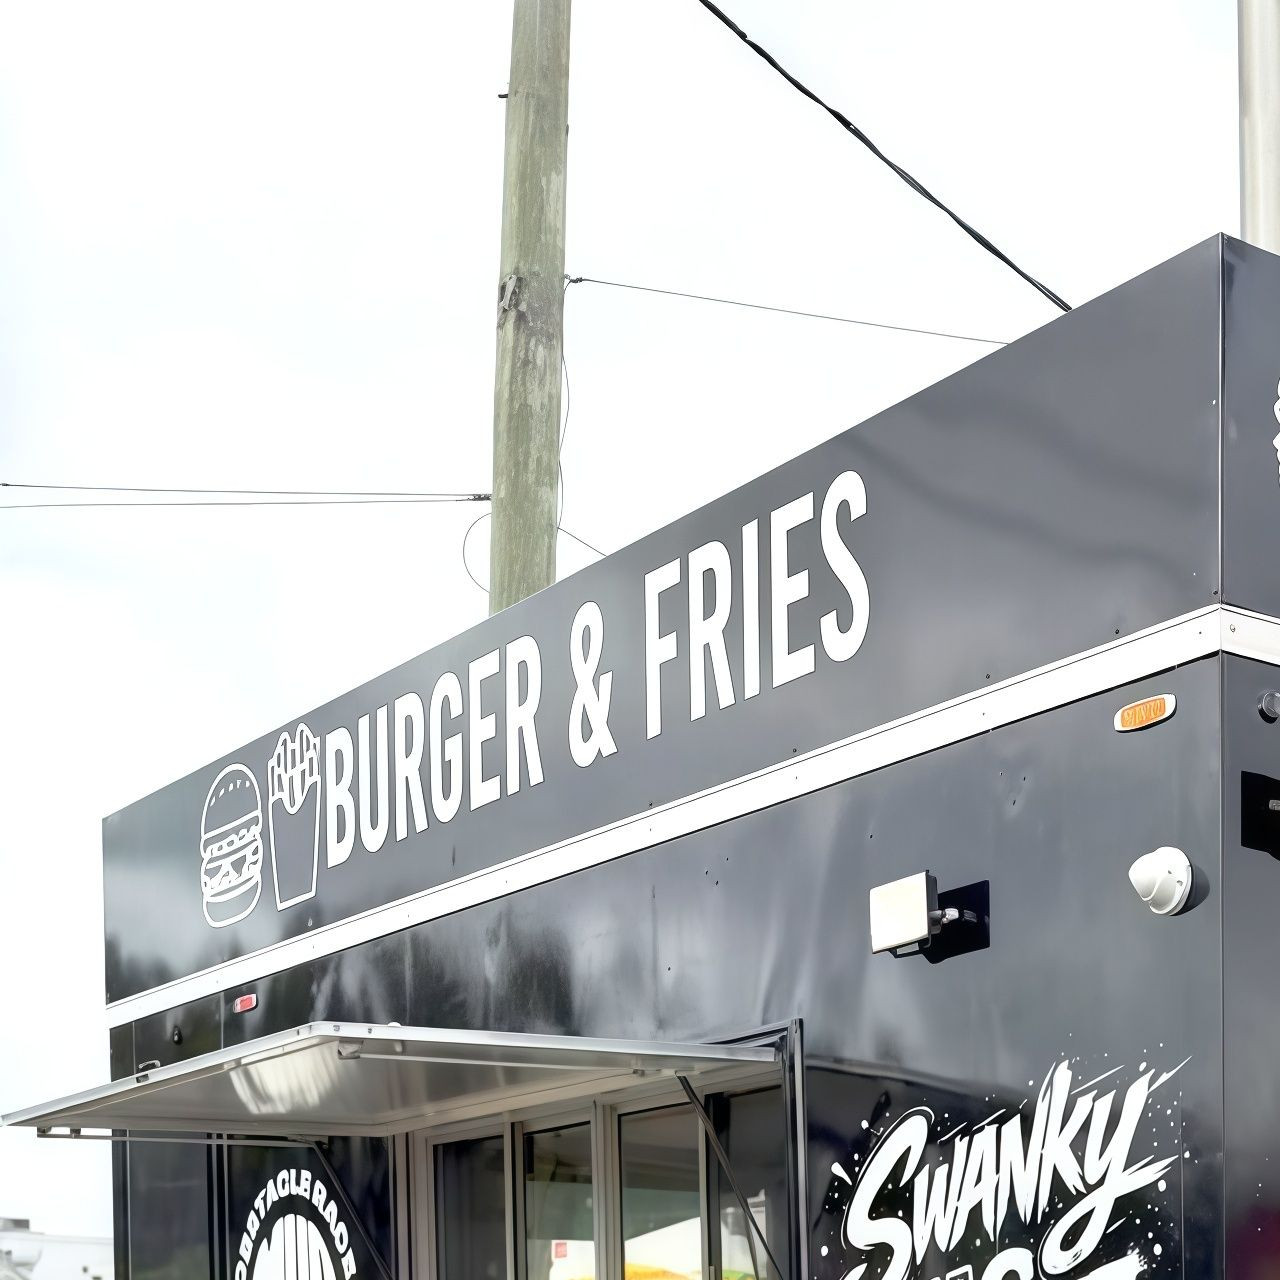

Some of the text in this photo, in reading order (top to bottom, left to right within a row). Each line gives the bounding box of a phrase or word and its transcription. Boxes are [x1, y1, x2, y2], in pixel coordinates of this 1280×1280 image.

[325, 470, 870, 869] BURGER & FRIES
